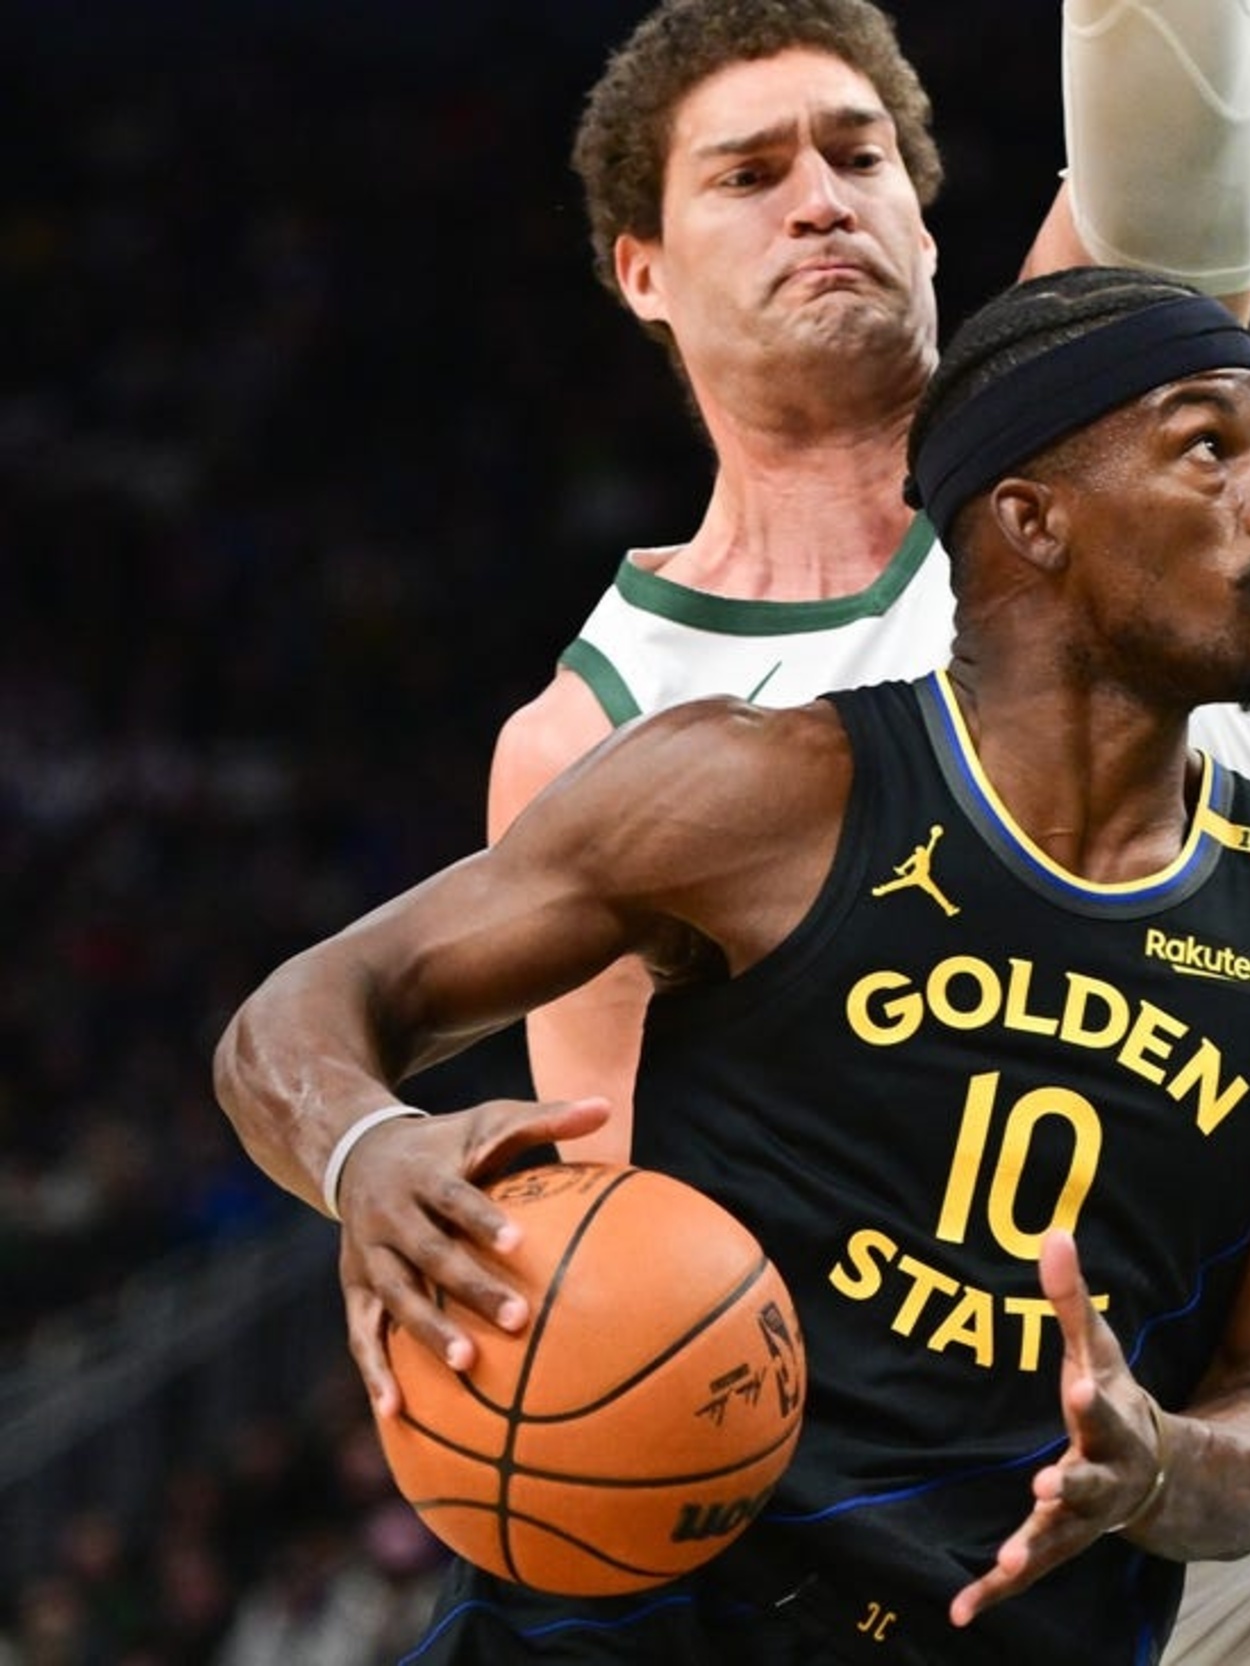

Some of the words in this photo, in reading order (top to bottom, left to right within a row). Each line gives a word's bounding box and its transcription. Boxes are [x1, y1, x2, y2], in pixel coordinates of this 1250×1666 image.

[846, 955, 1250, 1136] GOLDEN
[936, 1071, 1102, 1261] 10
[829, 1229, 1110, 1371] STAT
